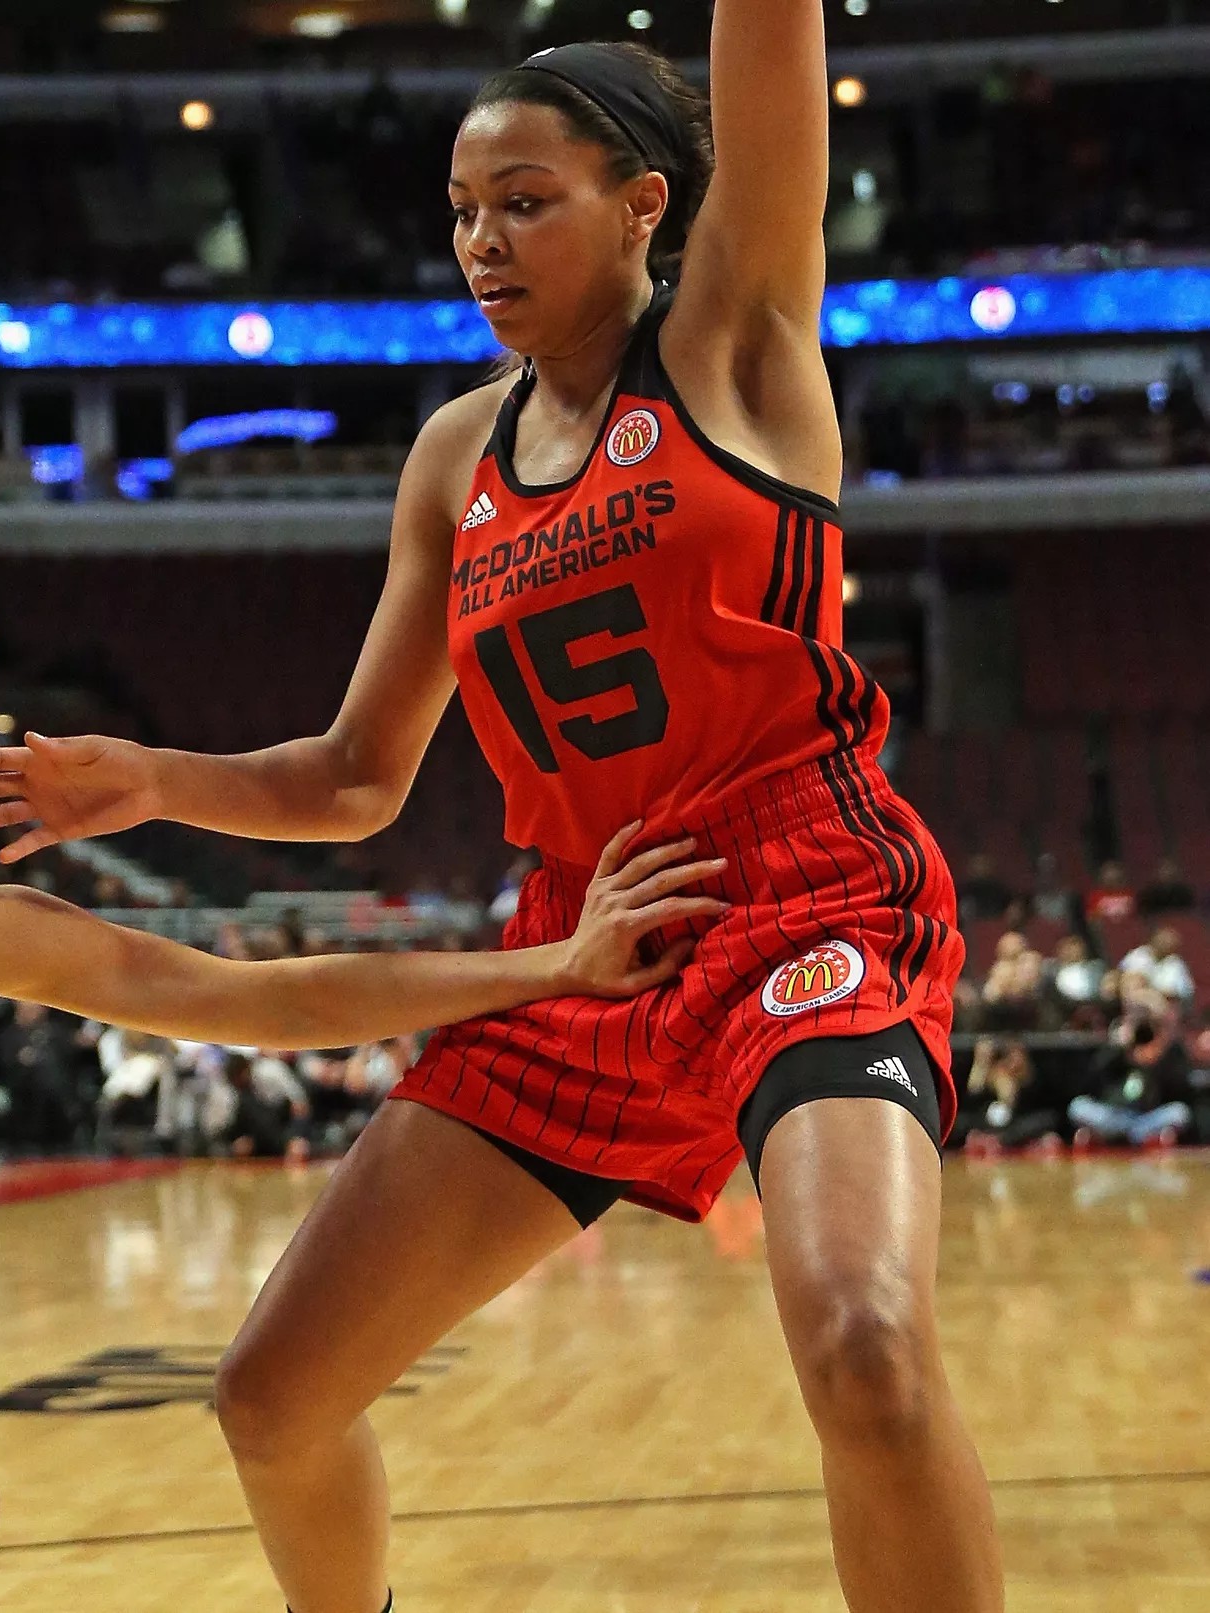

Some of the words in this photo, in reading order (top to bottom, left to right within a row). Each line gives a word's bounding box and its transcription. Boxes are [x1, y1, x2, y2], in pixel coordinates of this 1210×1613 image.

[461, 507, 498, 532] adidas
[458, 583, 494, 621] ALL
[499, 522, 656, 601] AMERICAN
[474, 583, 670, 774] 15
[779, 999, 821, 1014] AMERICAN
[823, 984, 851, 1003] GAMES
[866, 1065, 918, 1098] adidas
